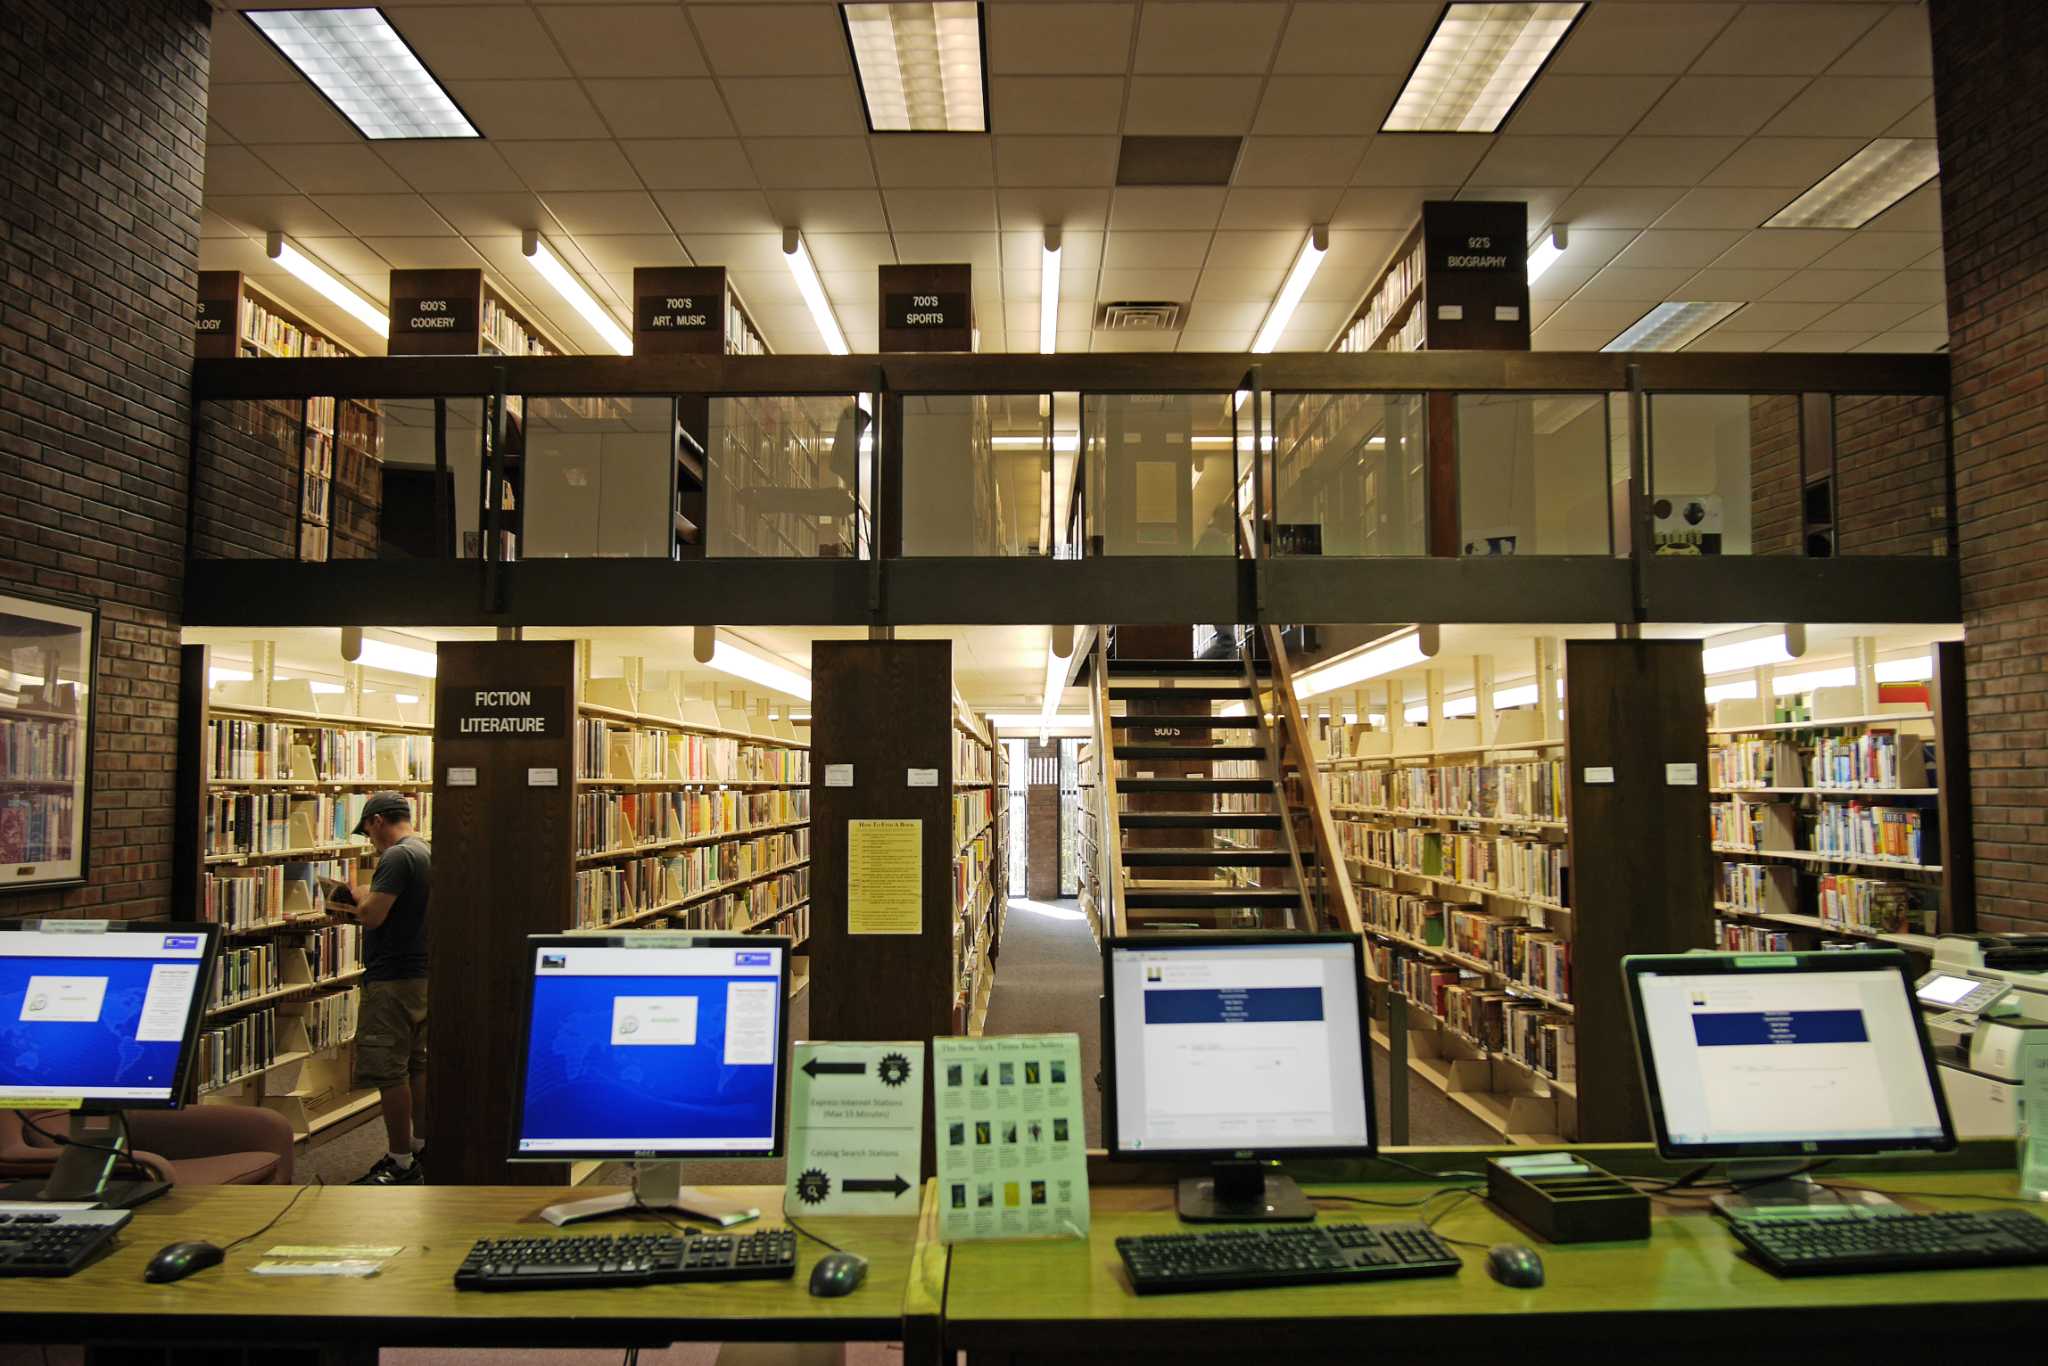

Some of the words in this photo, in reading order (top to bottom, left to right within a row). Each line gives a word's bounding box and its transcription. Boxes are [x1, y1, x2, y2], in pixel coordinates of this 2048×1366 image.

[1448, 256, 1507, 267] BIOGRAPHY
[420, 301, 447, 311] 600'S
[666, 298, 693, 309] 700'S
[913, 296, 939, 307] 700'S
[411, 317, 455, 328] COOKERY
[676, 315, 706, 326] MUSIC
[906, 313, 944, 324] SPORTS
[195, 319, 222, 330] LOGY
[475, 691, 531, 706] FICTION
[460, 717, 545, 732] LITERATURE
